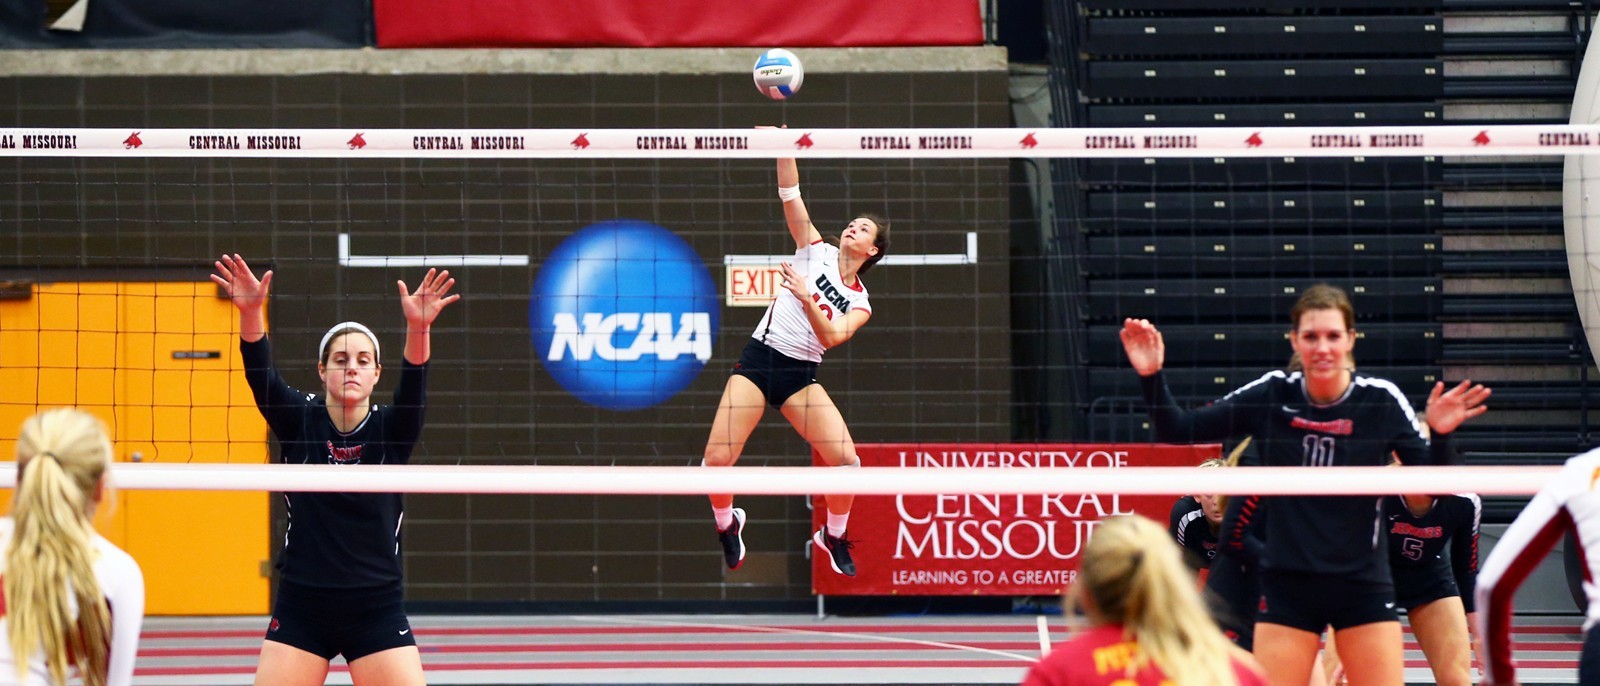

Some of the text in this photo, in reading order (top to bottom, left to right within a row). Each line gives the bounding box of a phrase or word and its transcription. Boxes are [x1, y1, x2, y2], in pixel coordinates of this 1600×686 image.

[0, 134, 77, 149] AL MISSOURI
[189, 135, 301, 149] CENTRAL MISSOURI
[413, 136, 525, 149] CENTRAL MISSOURI
[636, 136, 748, 149] CENTRAL MISSOURI
[861, 136, 972, 149] CENTRAL MISSOURI
[1085, 135, 1197, 148] CENTRAL MISSOURI
[1311, 134, 1425, 147] CENTRAL MISSOURI
[1539, 133, 1590, 146] CENTRAL
[732, 269, 778, 295] EXIT
[815, 273, 851, 314] UCM
[548, 312, 712, 362] NCAA
[892, 520, 1098, 559] MISSOU
[1402, 537, 1424, 561] 5
[892, 570, 1077, 585] LEARNING TO A GREATER
